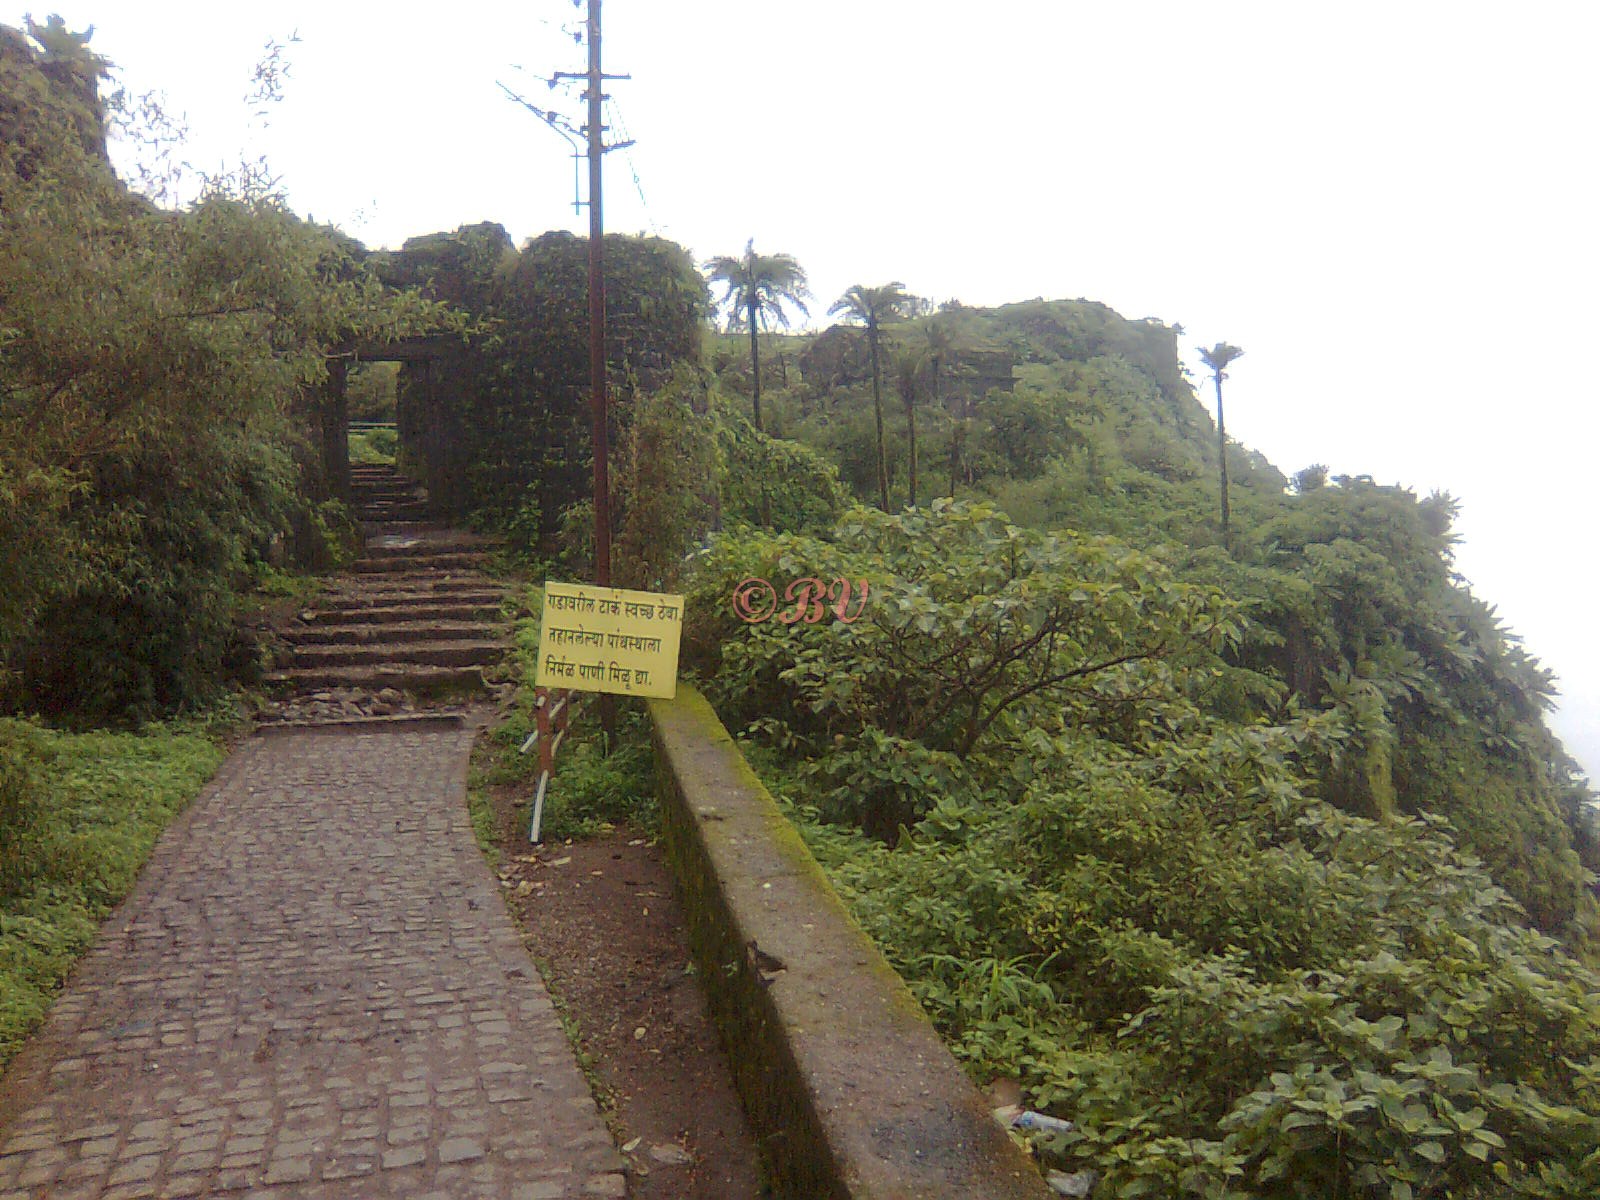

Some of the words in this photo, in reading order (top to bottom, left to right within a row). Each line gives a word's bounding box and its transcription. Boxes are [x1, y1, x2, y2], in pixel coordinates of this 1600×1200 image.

[547, 591, 596, 612] गडावरील
[624, 601, 656, 620] स्वच्छ
[579, 660, 606, 681] पाणी
